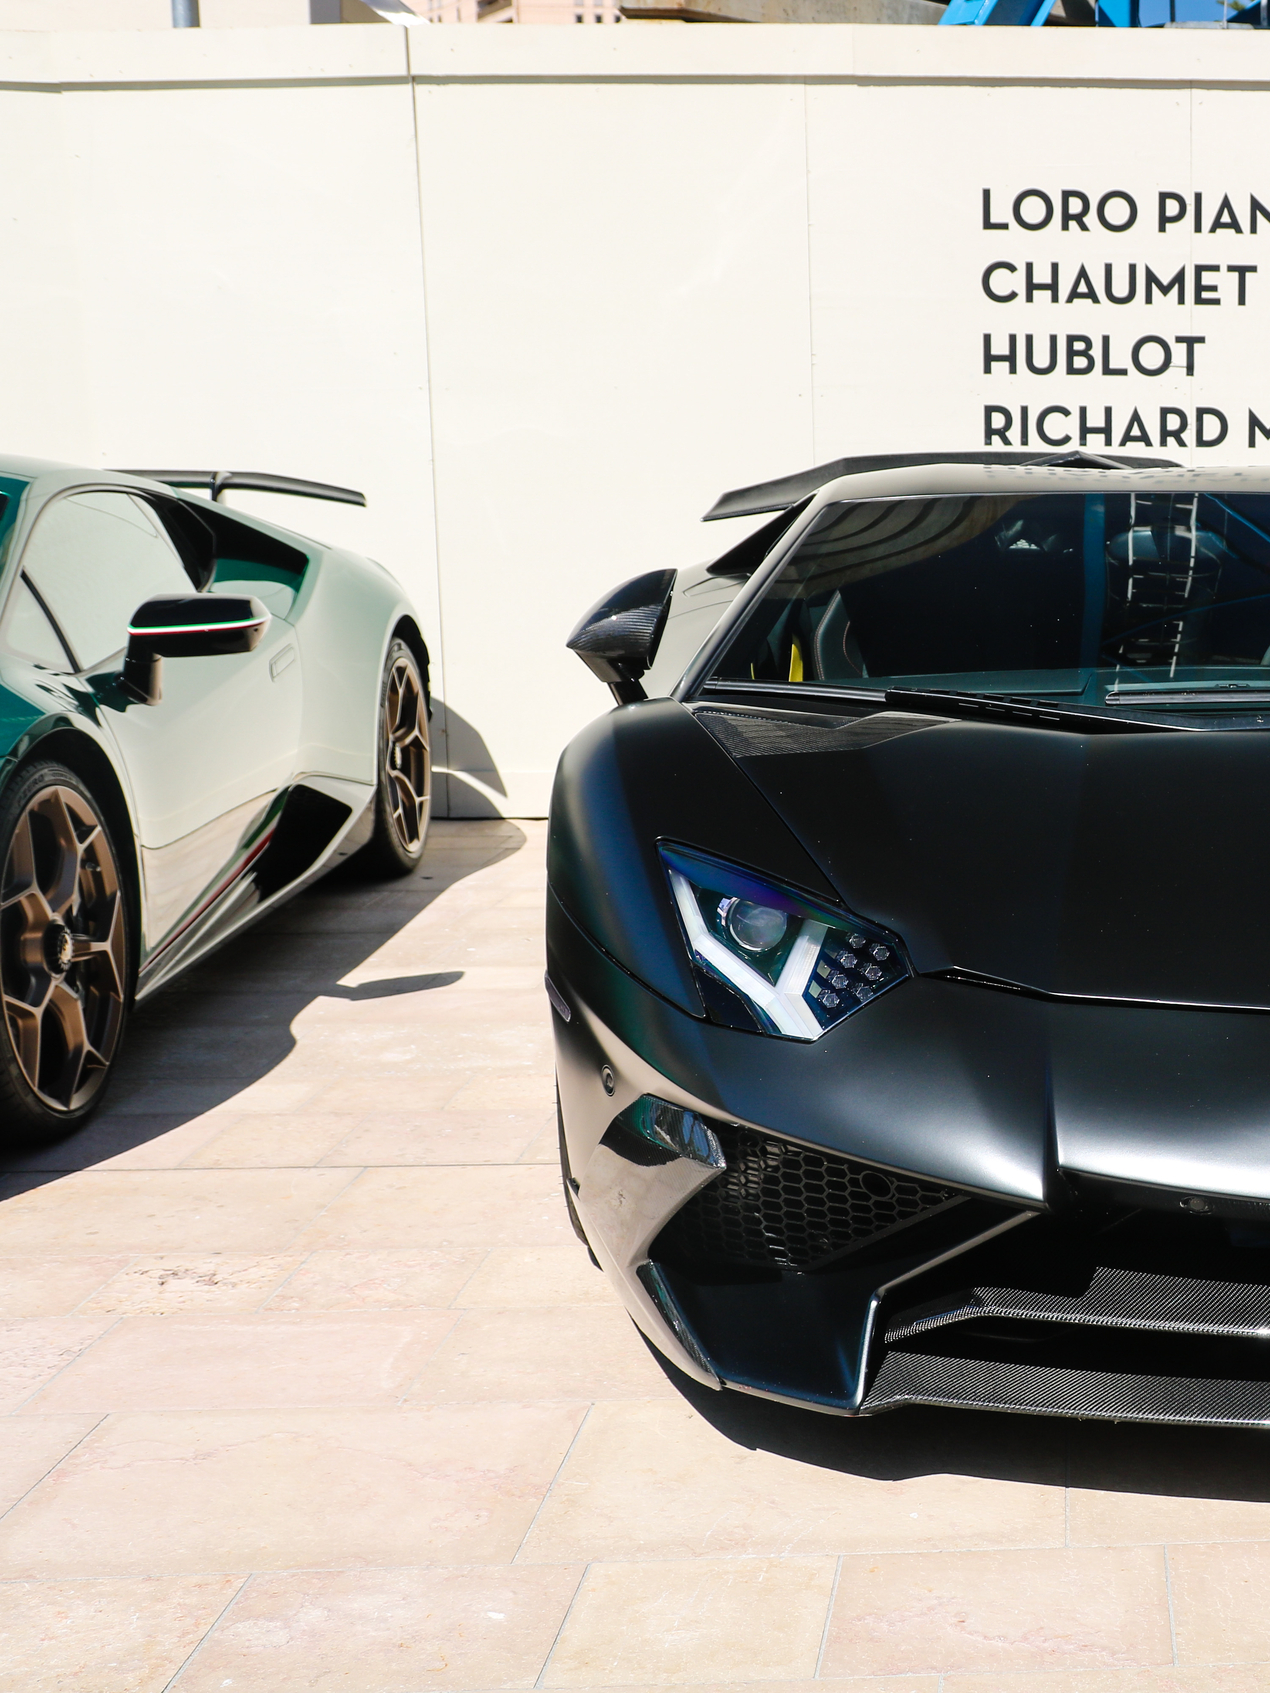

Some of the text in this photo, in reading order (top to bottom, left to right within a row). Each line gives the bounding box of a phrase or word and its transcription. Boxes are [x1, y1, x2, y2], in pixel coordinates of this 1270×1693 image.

[982, 188, 1138, 233] LORO
[981, 261, 1258, 306] CHAUMET
[983, 333, 1206, 377] HUBLOT
[984, 405, 1229, 448] RICHARD
